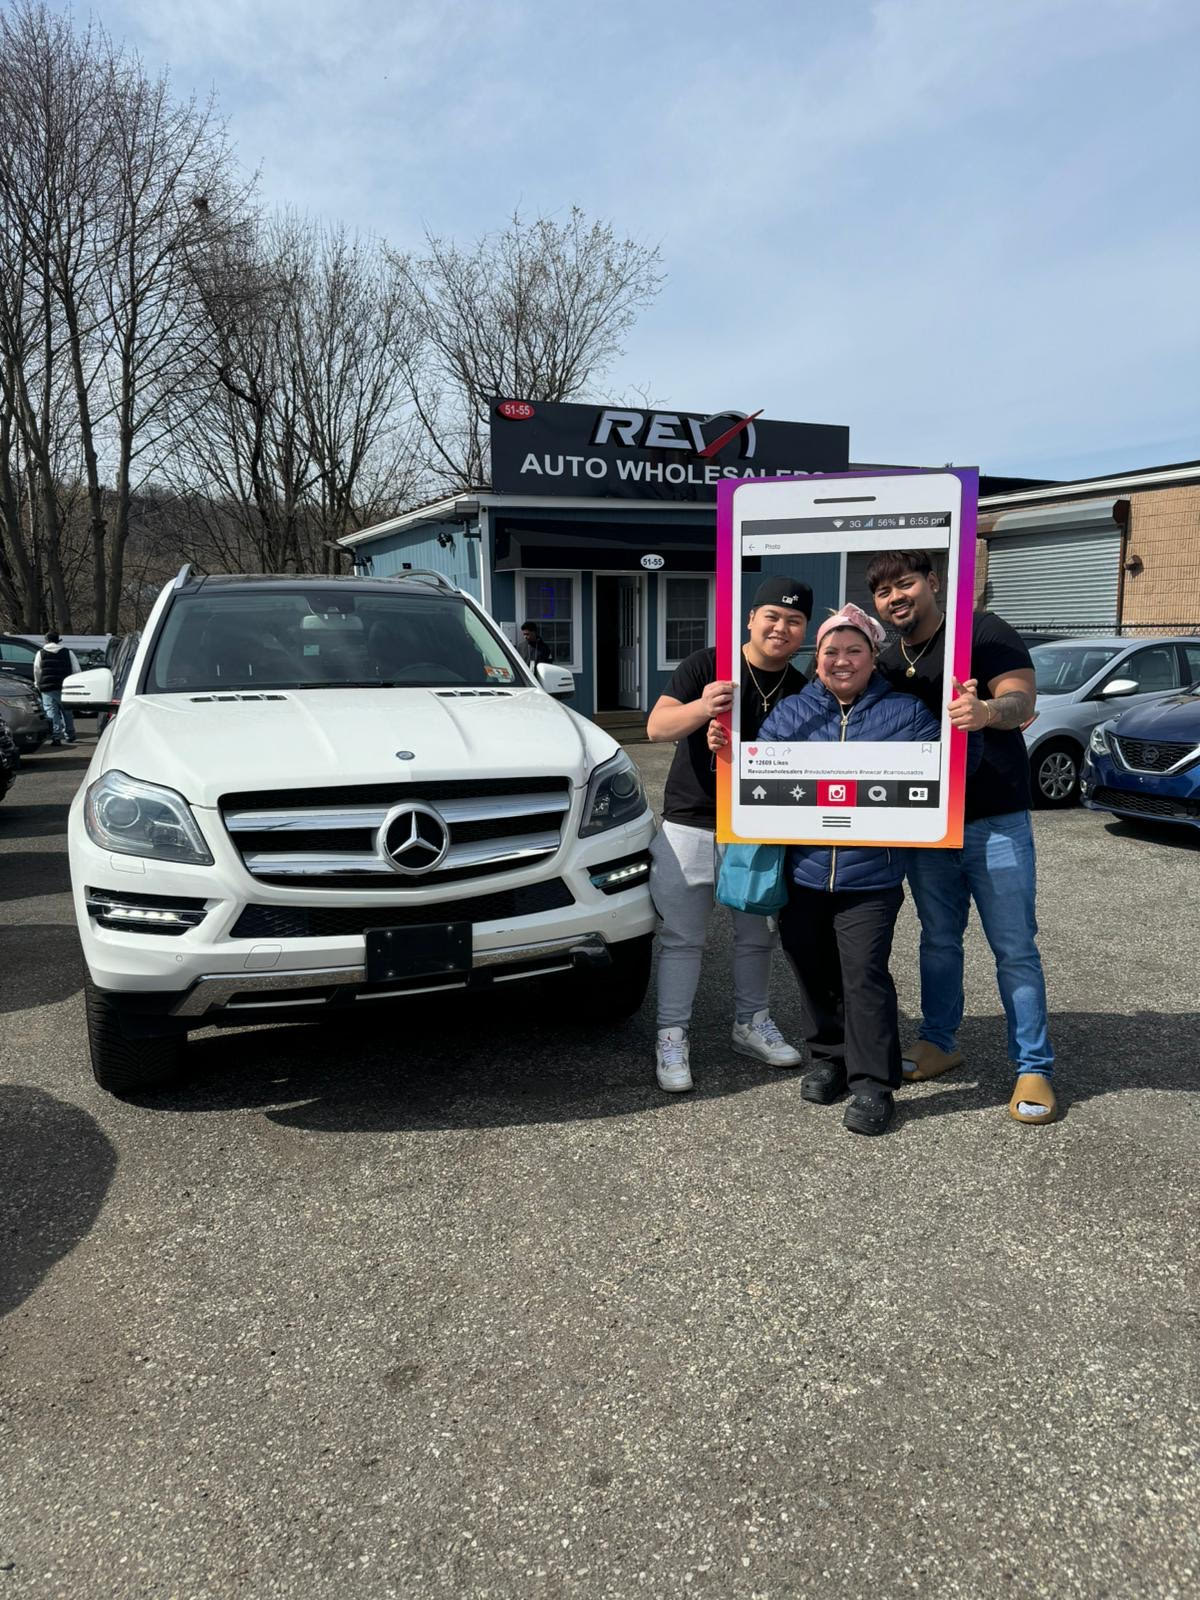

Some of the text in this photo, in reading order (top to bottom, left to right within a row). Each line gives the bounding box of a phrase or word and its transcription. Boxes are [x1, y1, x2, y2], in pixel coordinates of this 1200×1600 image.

[504, 404, 531, 416] 51-55
[594, 409, 764, 458] REV
[520, 453, 608, 478] AUTO
[850, 517, 946, 528] 3G 56% 6:55 pm
[643, 558, 662, 566] 51-55
